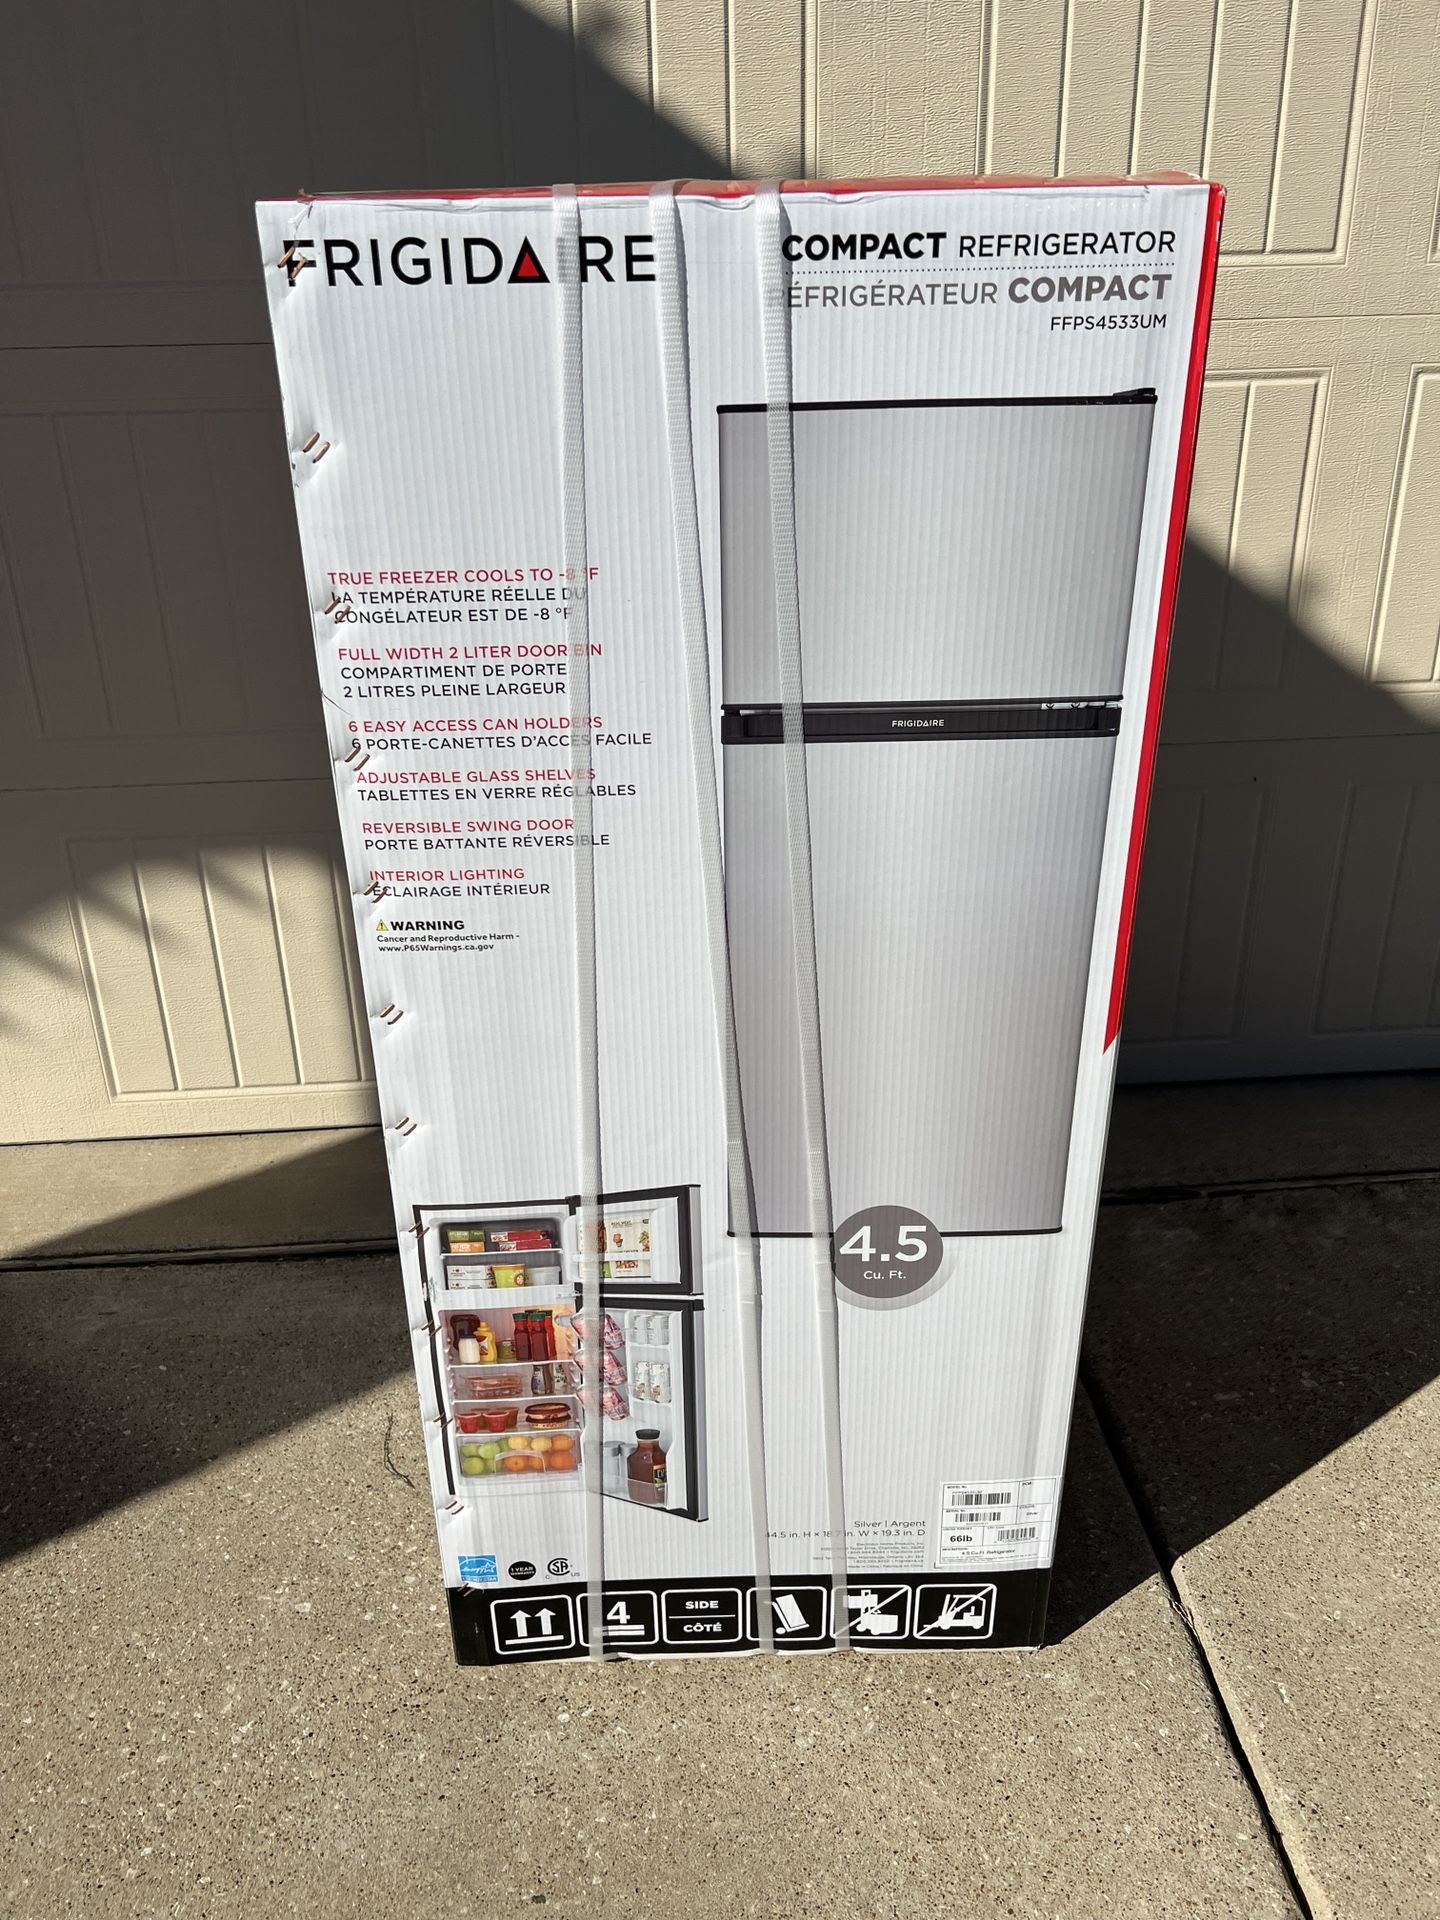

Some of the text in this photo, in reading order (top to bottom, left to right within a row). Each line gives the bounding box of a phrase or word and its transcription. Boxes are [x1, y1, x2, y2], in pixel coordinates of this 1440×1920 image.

[782, 231, 1176, 261] COMPACT REFRIGERATOR
[782, 274, 1173, 308] ÉFRIGÉRATEUR COMPACT
[1050, 314, 1167, 331] FFPS4533UM
[328, 572, 374, 585] TRUE
[379, 570, 458, 584] FREEZER
[464, 569, 524, 583] COOLS
[530, 568, 553, 581] TO
[358, 588, 485, 604] TEMPÉRATURE
[492, 586, 556, 602] RÉELLE
[335, 609, 462, 624] CONGÉLATEUR
[469, 609, 498, 622] EST
[505, 608, 528, 621] DE
[534, 608, 550, 621] -8
[338, 648, 380, 661] FULL
[386, 647, 443, 660] WIDTH
[449, 647, 458, 659] 2
[464, 645, 511, 659] LITER
[517, 644, 568, 658] DOOR
[341, 663, 567, 680] COMPARTIMENT DE PORTE
[344, 682, 566, 698] 2 LITRES PLEINE LARGEUR
[348, 721, 358, 733] 6
[364, 720, 406, 733] EASY
[412, 719, 477, 732] ACCESS
[483, 718, 518, 731] CAN
[892, 719, 944, 728] FRIGIDAIRE
[351, 738, 361, 749] 6
[366, 736, 516, 750] PORTE-CANETTES
[595, 733, 652, 746] FACILE
[357, 771, 461, 784] ADJUSTABLE
[467, 770, 520, 783] GLASS
[357, 789, 450, 801] TABLETTES
[455, 788, 477, 800] EN
[482, 787, 536, 799] VERRE
[362, 819, 574, 834] REVERSIBLE SWING DOOR
[364, 839, 418, 851] PORTE
[423, 837, 507, 850] BATTANTE
[369, 868, 525, 882] INTERIOR LIGHTING
[467, 882, 550, 897] INTÉRIEUR
[390, 920, 465, 931] WARNING
[377, 934, 408, 943] Cancer
[410, 934, 426, 942] and
[428, 933, 487, 943] Reproductive
[489, 932, 514, 940] Harm
[378, 943, 494, 953] www.P65Warnings.ca.gov
[839, 1225, 928, 1262] 4.5
[863, 1269, 906, 1280] Cu. Ft.
[891, 1520, 926, 1530] Argent
[950, 1535, 973, 1543] 66lb
[685, 1600, 719, 1609] SIDE
[606, 1601, 630, 1624] 4
[683, 1621, 722, 1633] CÔTÉ
